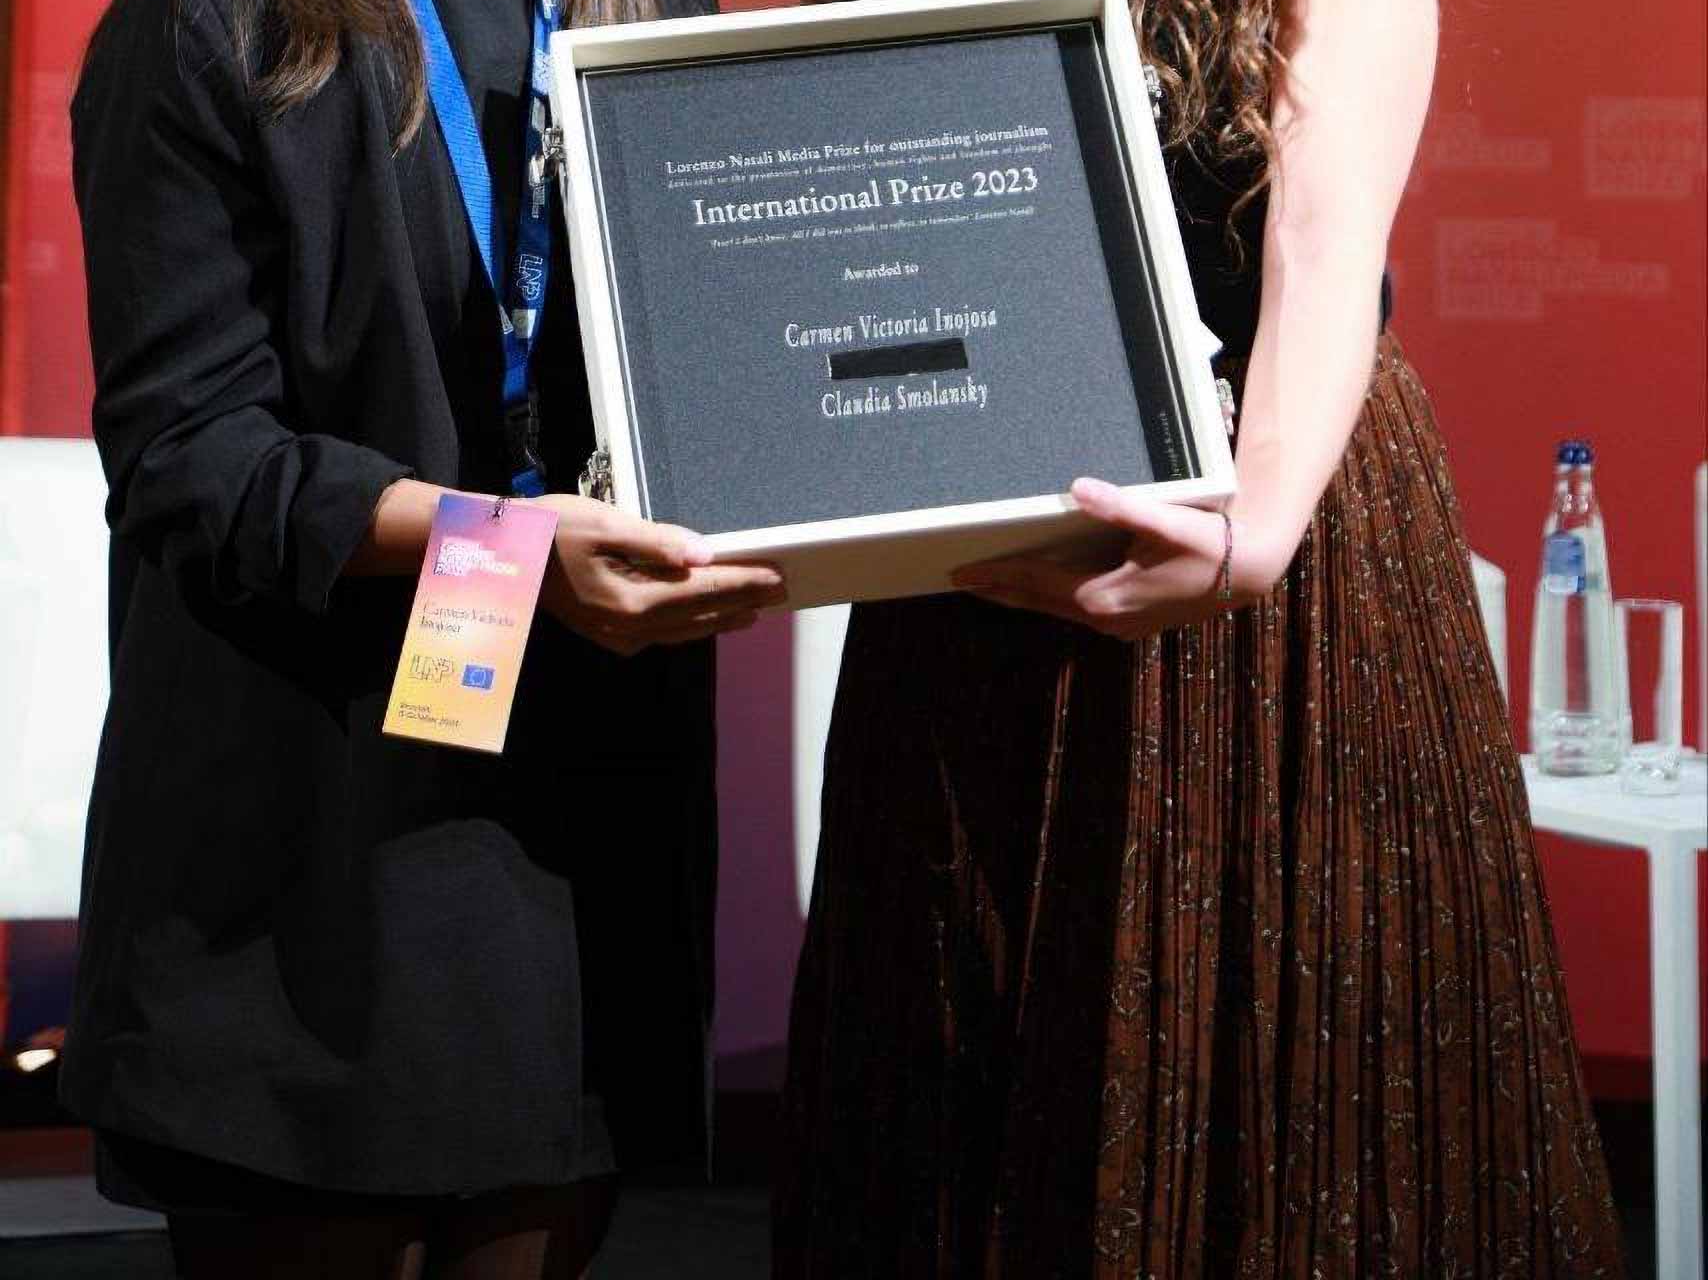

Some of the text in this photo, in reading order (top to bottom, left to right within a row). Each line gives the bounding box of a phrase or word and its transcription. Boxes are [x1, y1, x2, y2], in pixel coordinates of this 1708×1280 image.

[665, 125, 1049, 174] Lorenzo Natali Media Prize for outstanding journalism
[693, 167, 1038, 225] International Prize 2023
[843, 261, 902, 281] Awarded
[784, 304, 998, 348] Carmen Victoria Inojosa
[821, 376, 988, 417] Claudia Smolansky
